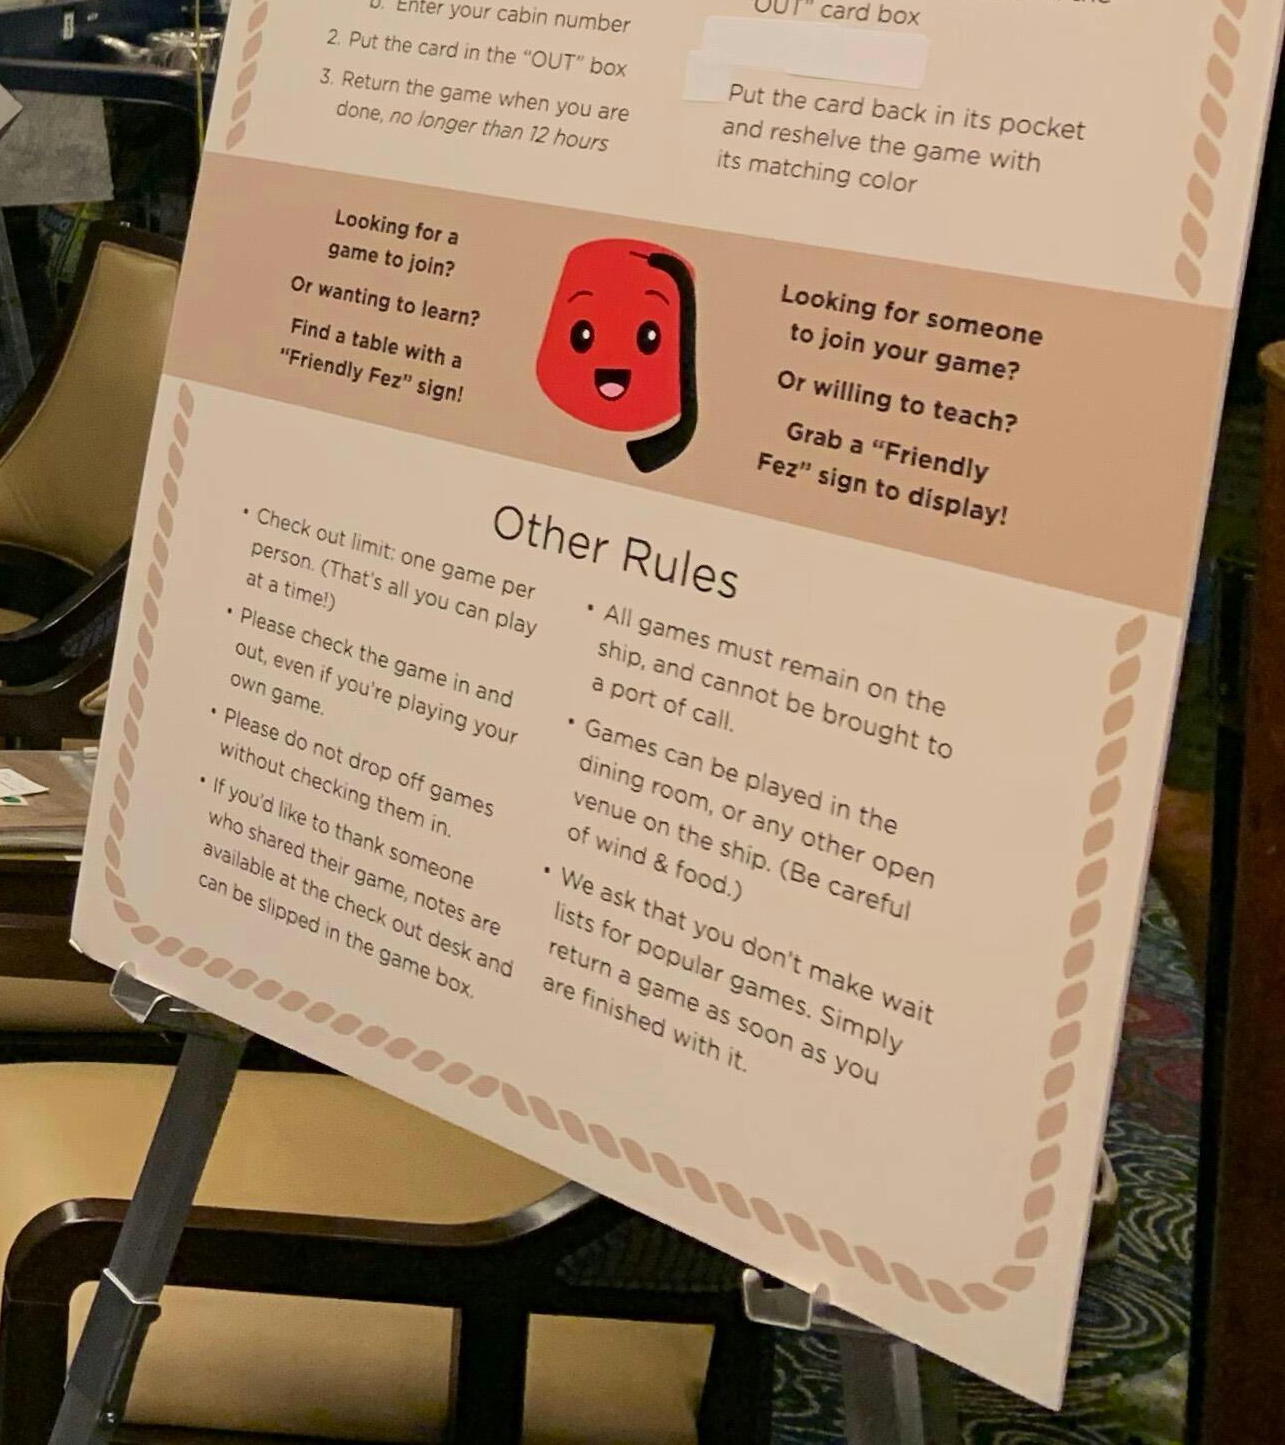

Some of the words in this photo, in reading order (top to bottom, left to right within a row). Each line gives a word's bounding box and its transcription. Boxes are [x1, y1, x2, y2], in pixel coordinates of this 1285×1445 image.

[716, 149, 741, 170] its
[747, 156, 851, 189] matching
[857, 169, 918, 193] color
[721, 118, 764, 139] and
[768, 124, 862, 151] reshelve
[868, 133, 906, 157] the
[912, 142, 981, 166] game
[988, 148, 1041, 173] with
[333, 207, 410, 241] Looking
[414, 220, 443, 242] for
[446, 230, 459, 246] a
[780, 283, 877, 321] Looking
[883, 299, 920, 324] for
[924, 311, 1043, 346] someone
[493, 504, 610, 564] Other
[622, 535, 738, 599] Rules
[602, 603, 632, 628] All
[637, 616, 711, 650] games
[716, 638, 774, 668] must
[778, 655, 859, 693] remain
[866, 681, 898, 704] on
[905, 688, 946, 717] the
